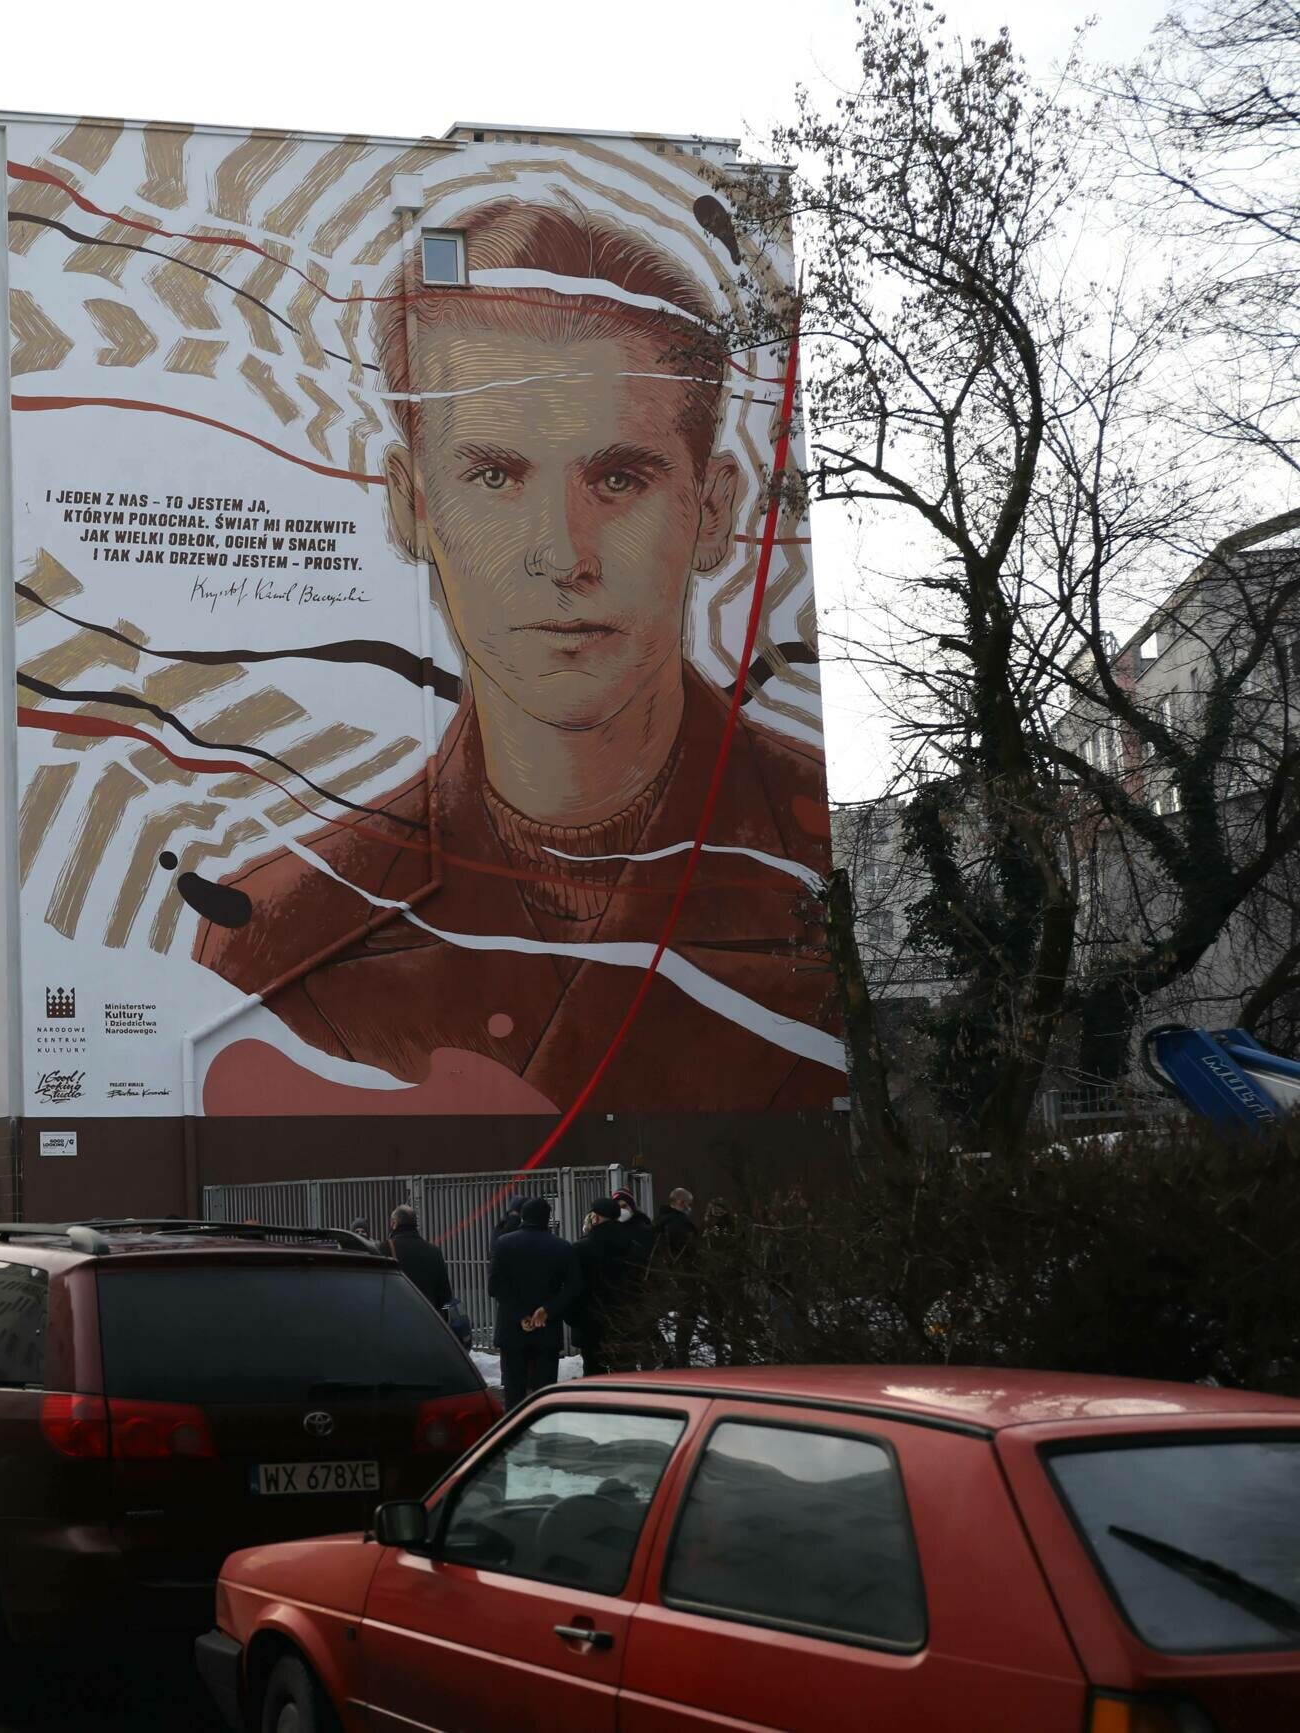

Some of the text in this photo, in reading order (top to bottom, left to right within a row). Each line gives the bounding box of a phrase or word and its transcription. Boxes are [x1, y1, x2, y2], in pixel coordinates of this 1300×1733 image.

[46, 490, 51, 502] I
[55, 490, 101, 505] JEDEN
[105, 492, 115, 506] Z
[118, 493, 148, 507] NAS
[165, 495, 183, 509] TO
[188, 496, 243, 511] JESTEM
[248, 500, 270, 514] JA,
[63, 507, 357, 534] KTÓRYM POKOCHAŁ. ŚWIAT MI ROZKWITŁ
[80, 528, 336, 552] JAK WIELKI OBŁOK, OGIEŃ W SNACH
[93, 548, 99, 561] I
[104, 549, 131, 562] TAK
[135, 550, 164, 564] JAK
[169, 551, 228, 567] DRZEWO
[233, 554, 288, 569] JESTEM
[304, 556, 362, 571] PROSTY.
[104, 1011, 144, 1021] Kultury
[263, 1462, 377, 1492] WX 678XE
